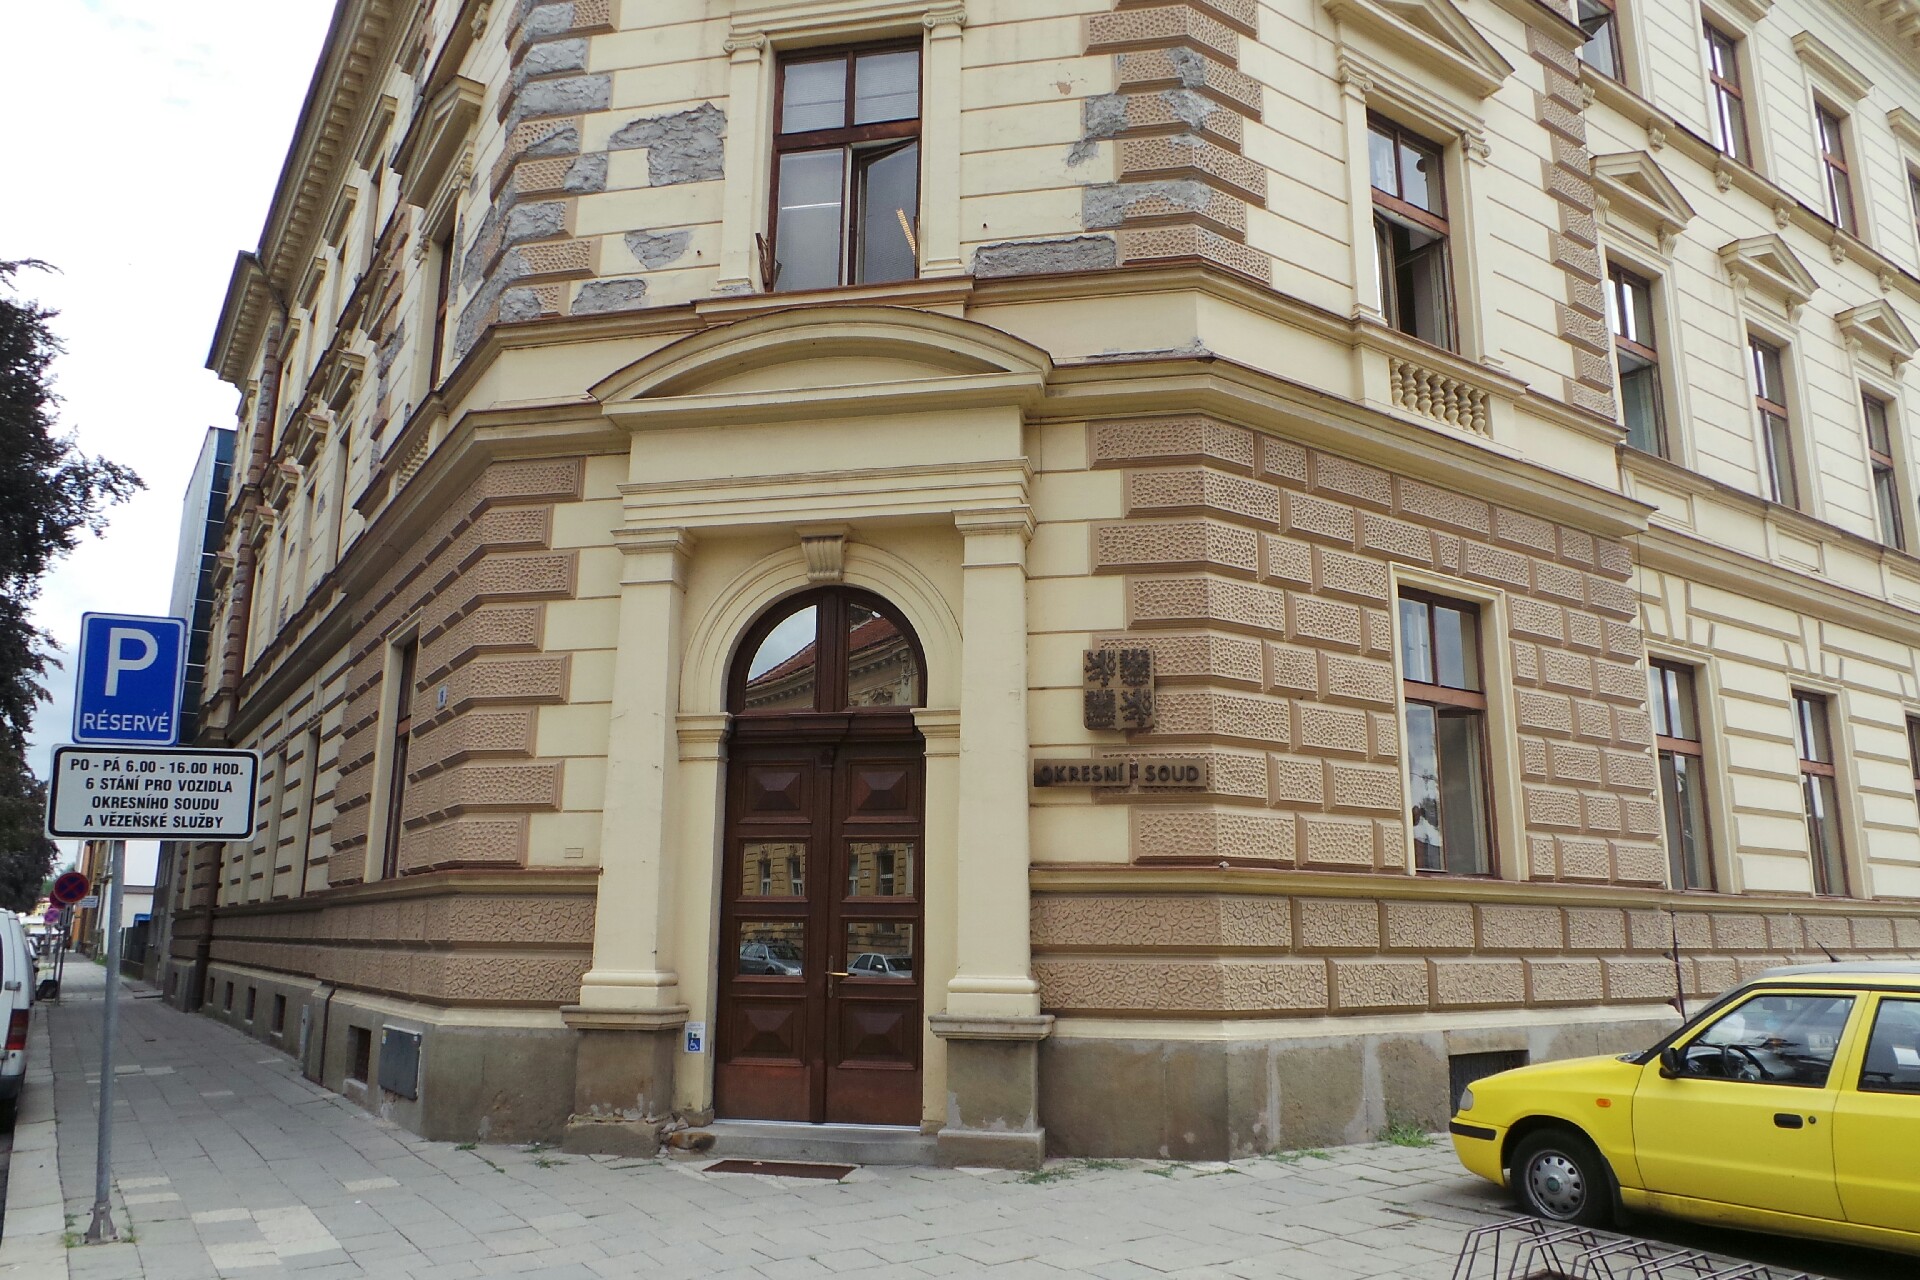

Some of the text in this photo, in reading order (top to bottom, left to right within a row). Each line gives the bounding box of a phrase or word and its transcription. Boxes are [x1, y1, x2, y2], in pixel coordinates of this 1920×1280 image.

[104, 627, 158, 696] P
[82, 709, 169, 733] RÉSERVÉ
[70, 758, 90, 771] PO
[103, 757, 121, 772] PÁ
[126, 760, 156, 773] 6.00
[169, 762, 208, 774] 16.00
[212, 763, 244, 776] HOD.
[1040, 763, 1200, 783] OKRESNÍ SOUD
[85, 775, 233, 793] 6 STÁNÍ PRO VOZIDLA
[92, 795, 220, 810] OKRESNÍHO SOUDU
[84, 811, 224, 829] A VĚZEŇSKÉ SLUŽBY
